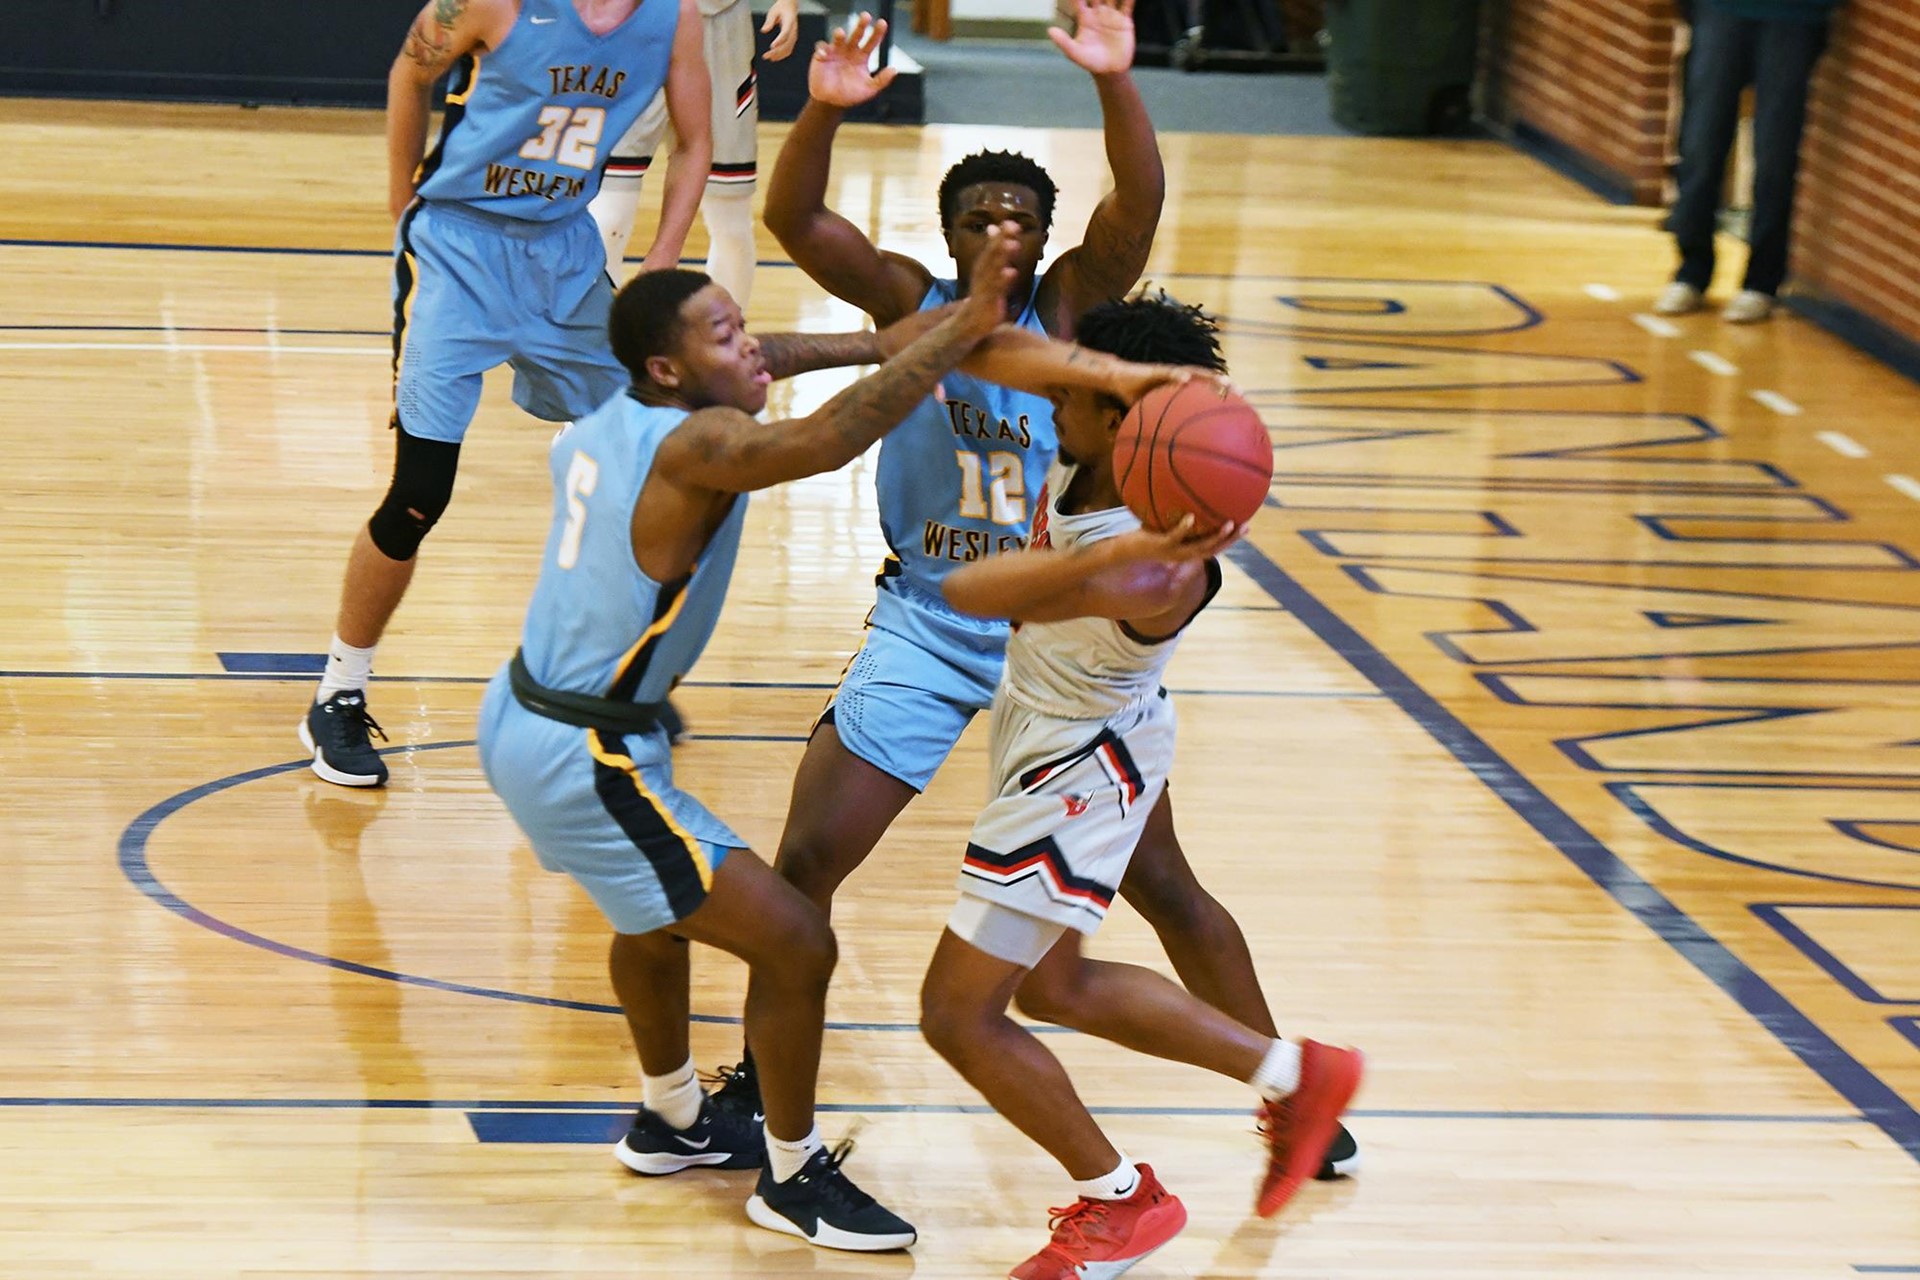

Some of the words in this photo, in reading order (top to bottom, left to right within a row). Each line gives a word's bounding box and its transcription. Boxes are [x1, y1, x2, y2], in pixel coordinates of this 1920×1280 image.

[549, 65, 626, 99] TEXAS
[518, 105, 606, 171] 32
[946, 400, 1031, 449] TEXAS
[557, 449, 598, 569] 5
[956, 449, 1027, 526] 12
